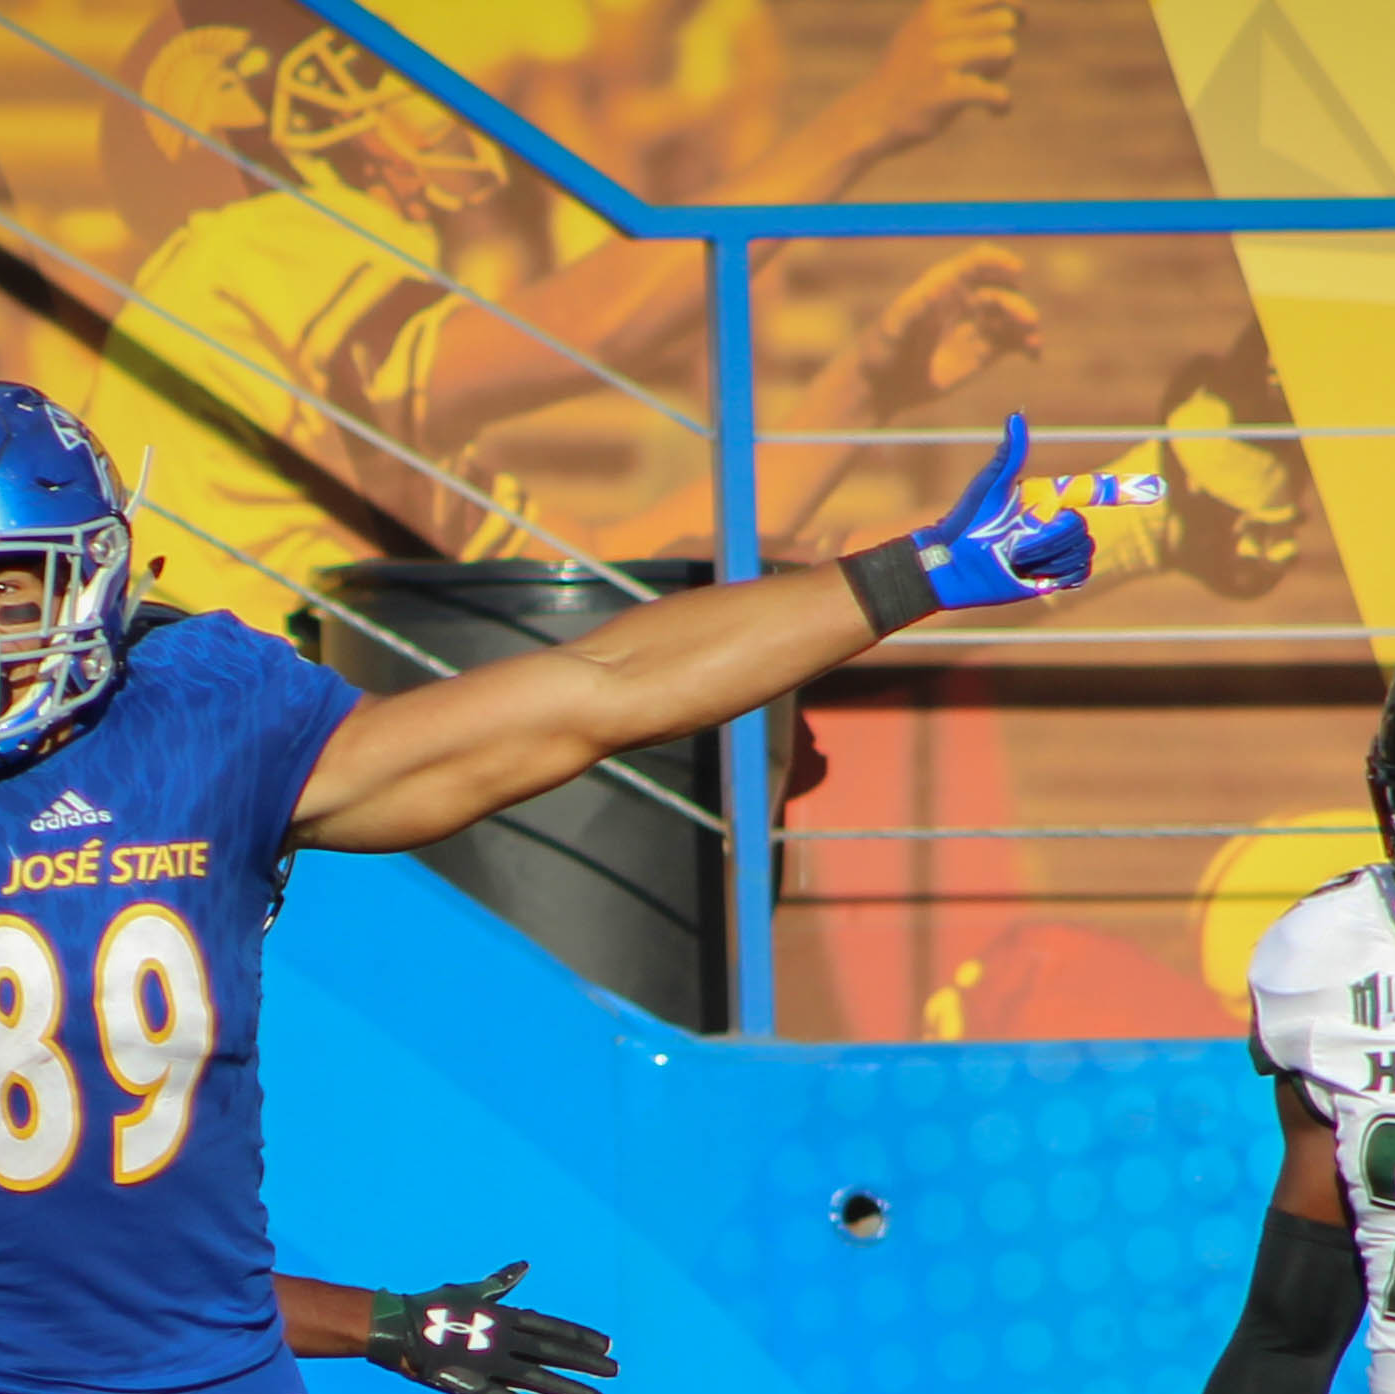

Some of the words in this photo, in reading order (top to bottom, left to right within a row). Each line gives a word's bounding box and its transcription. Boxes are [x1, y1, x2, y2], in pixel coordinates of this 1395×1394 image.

[30, 810, 112, 832] adidas
[1, 839, 104, 896] JOSÉ
[110, 842, 210, 884] STATE
